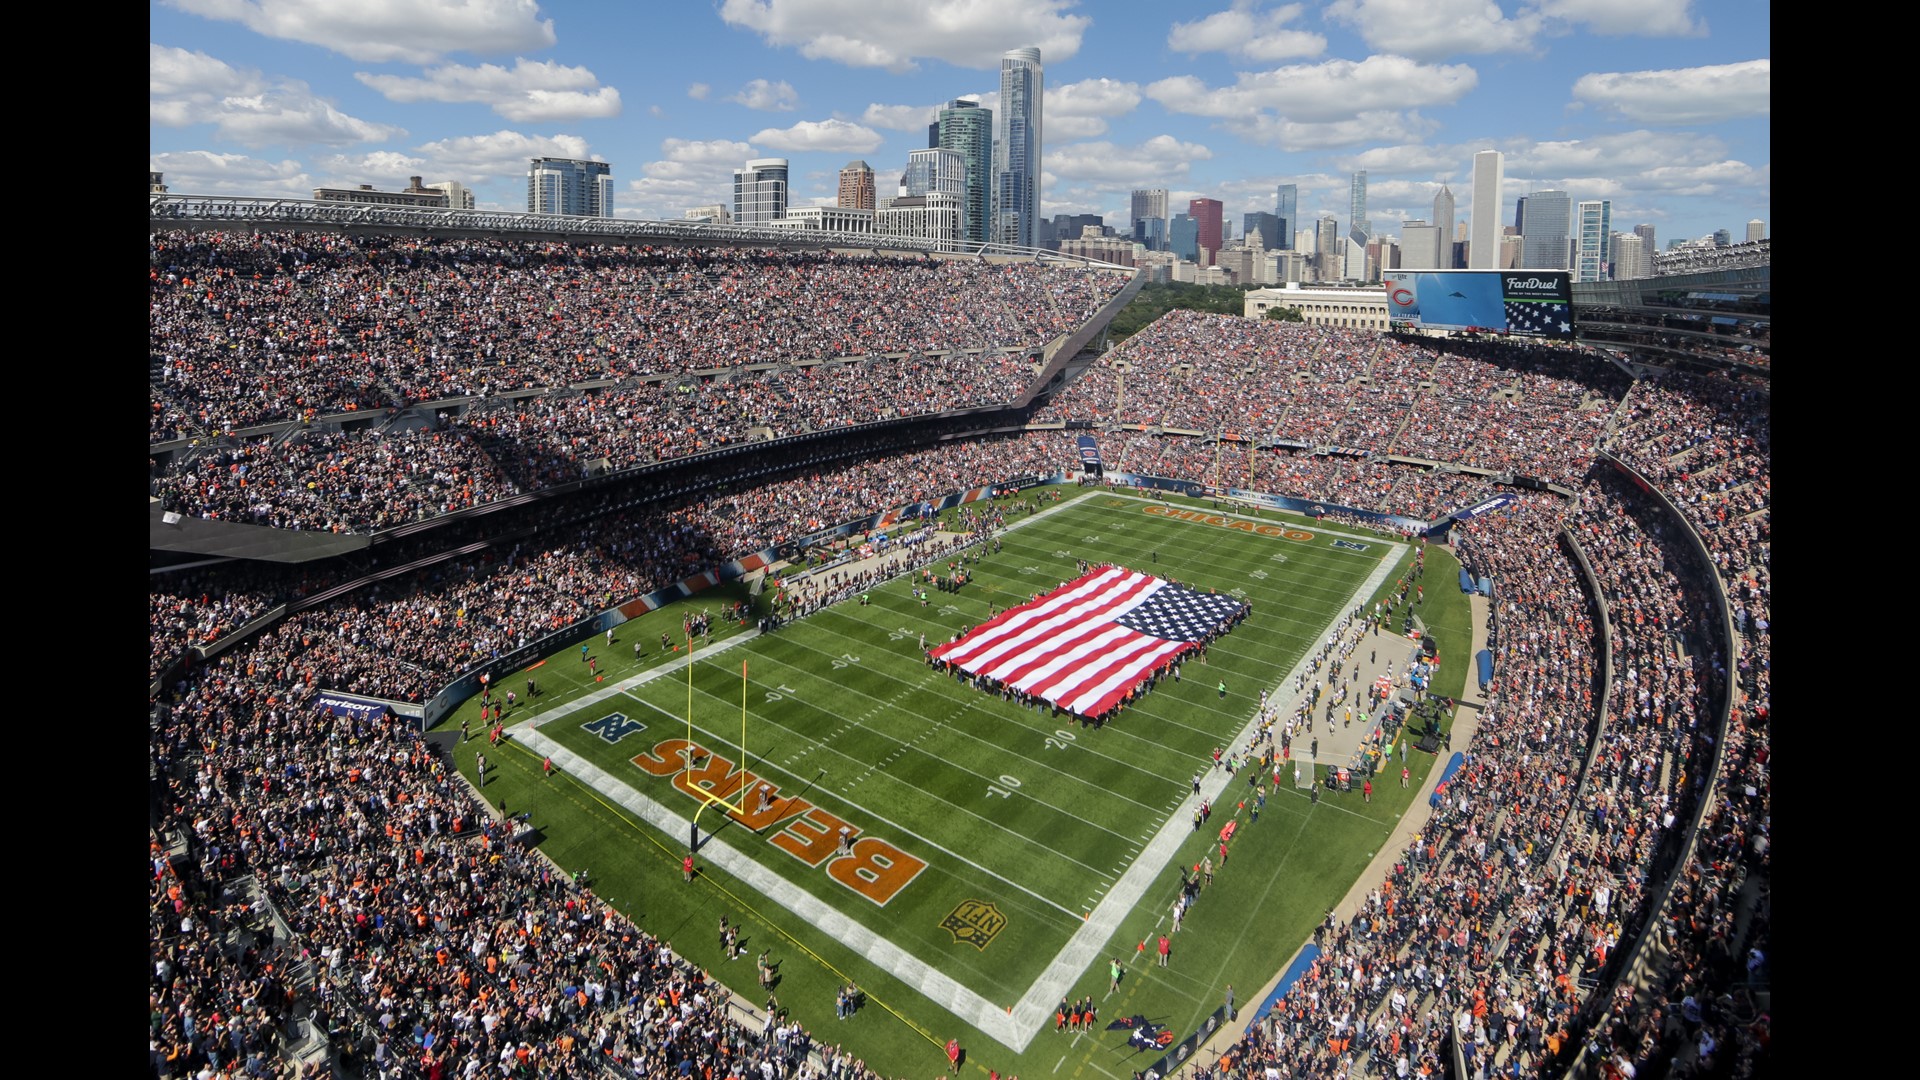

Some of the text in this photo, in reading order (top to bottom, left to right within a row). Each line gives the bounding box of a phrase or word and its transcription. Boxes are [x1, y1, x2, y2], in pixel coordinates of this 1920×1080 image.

[1506, 277, 1559, 290] FanDuel
[1142, 505, 1316, 542] CHICAGO
[831, 653, 860, 669] 20
[765, 684, 797, 702] 10
[319, 697, 372, 712] verizon
[1044, 729, 1077, 751] 20
[986, 774, 1022, 799] 10
[629, 738, 929, 908] BEARS
[961, 903, 1002, 933] NFL
